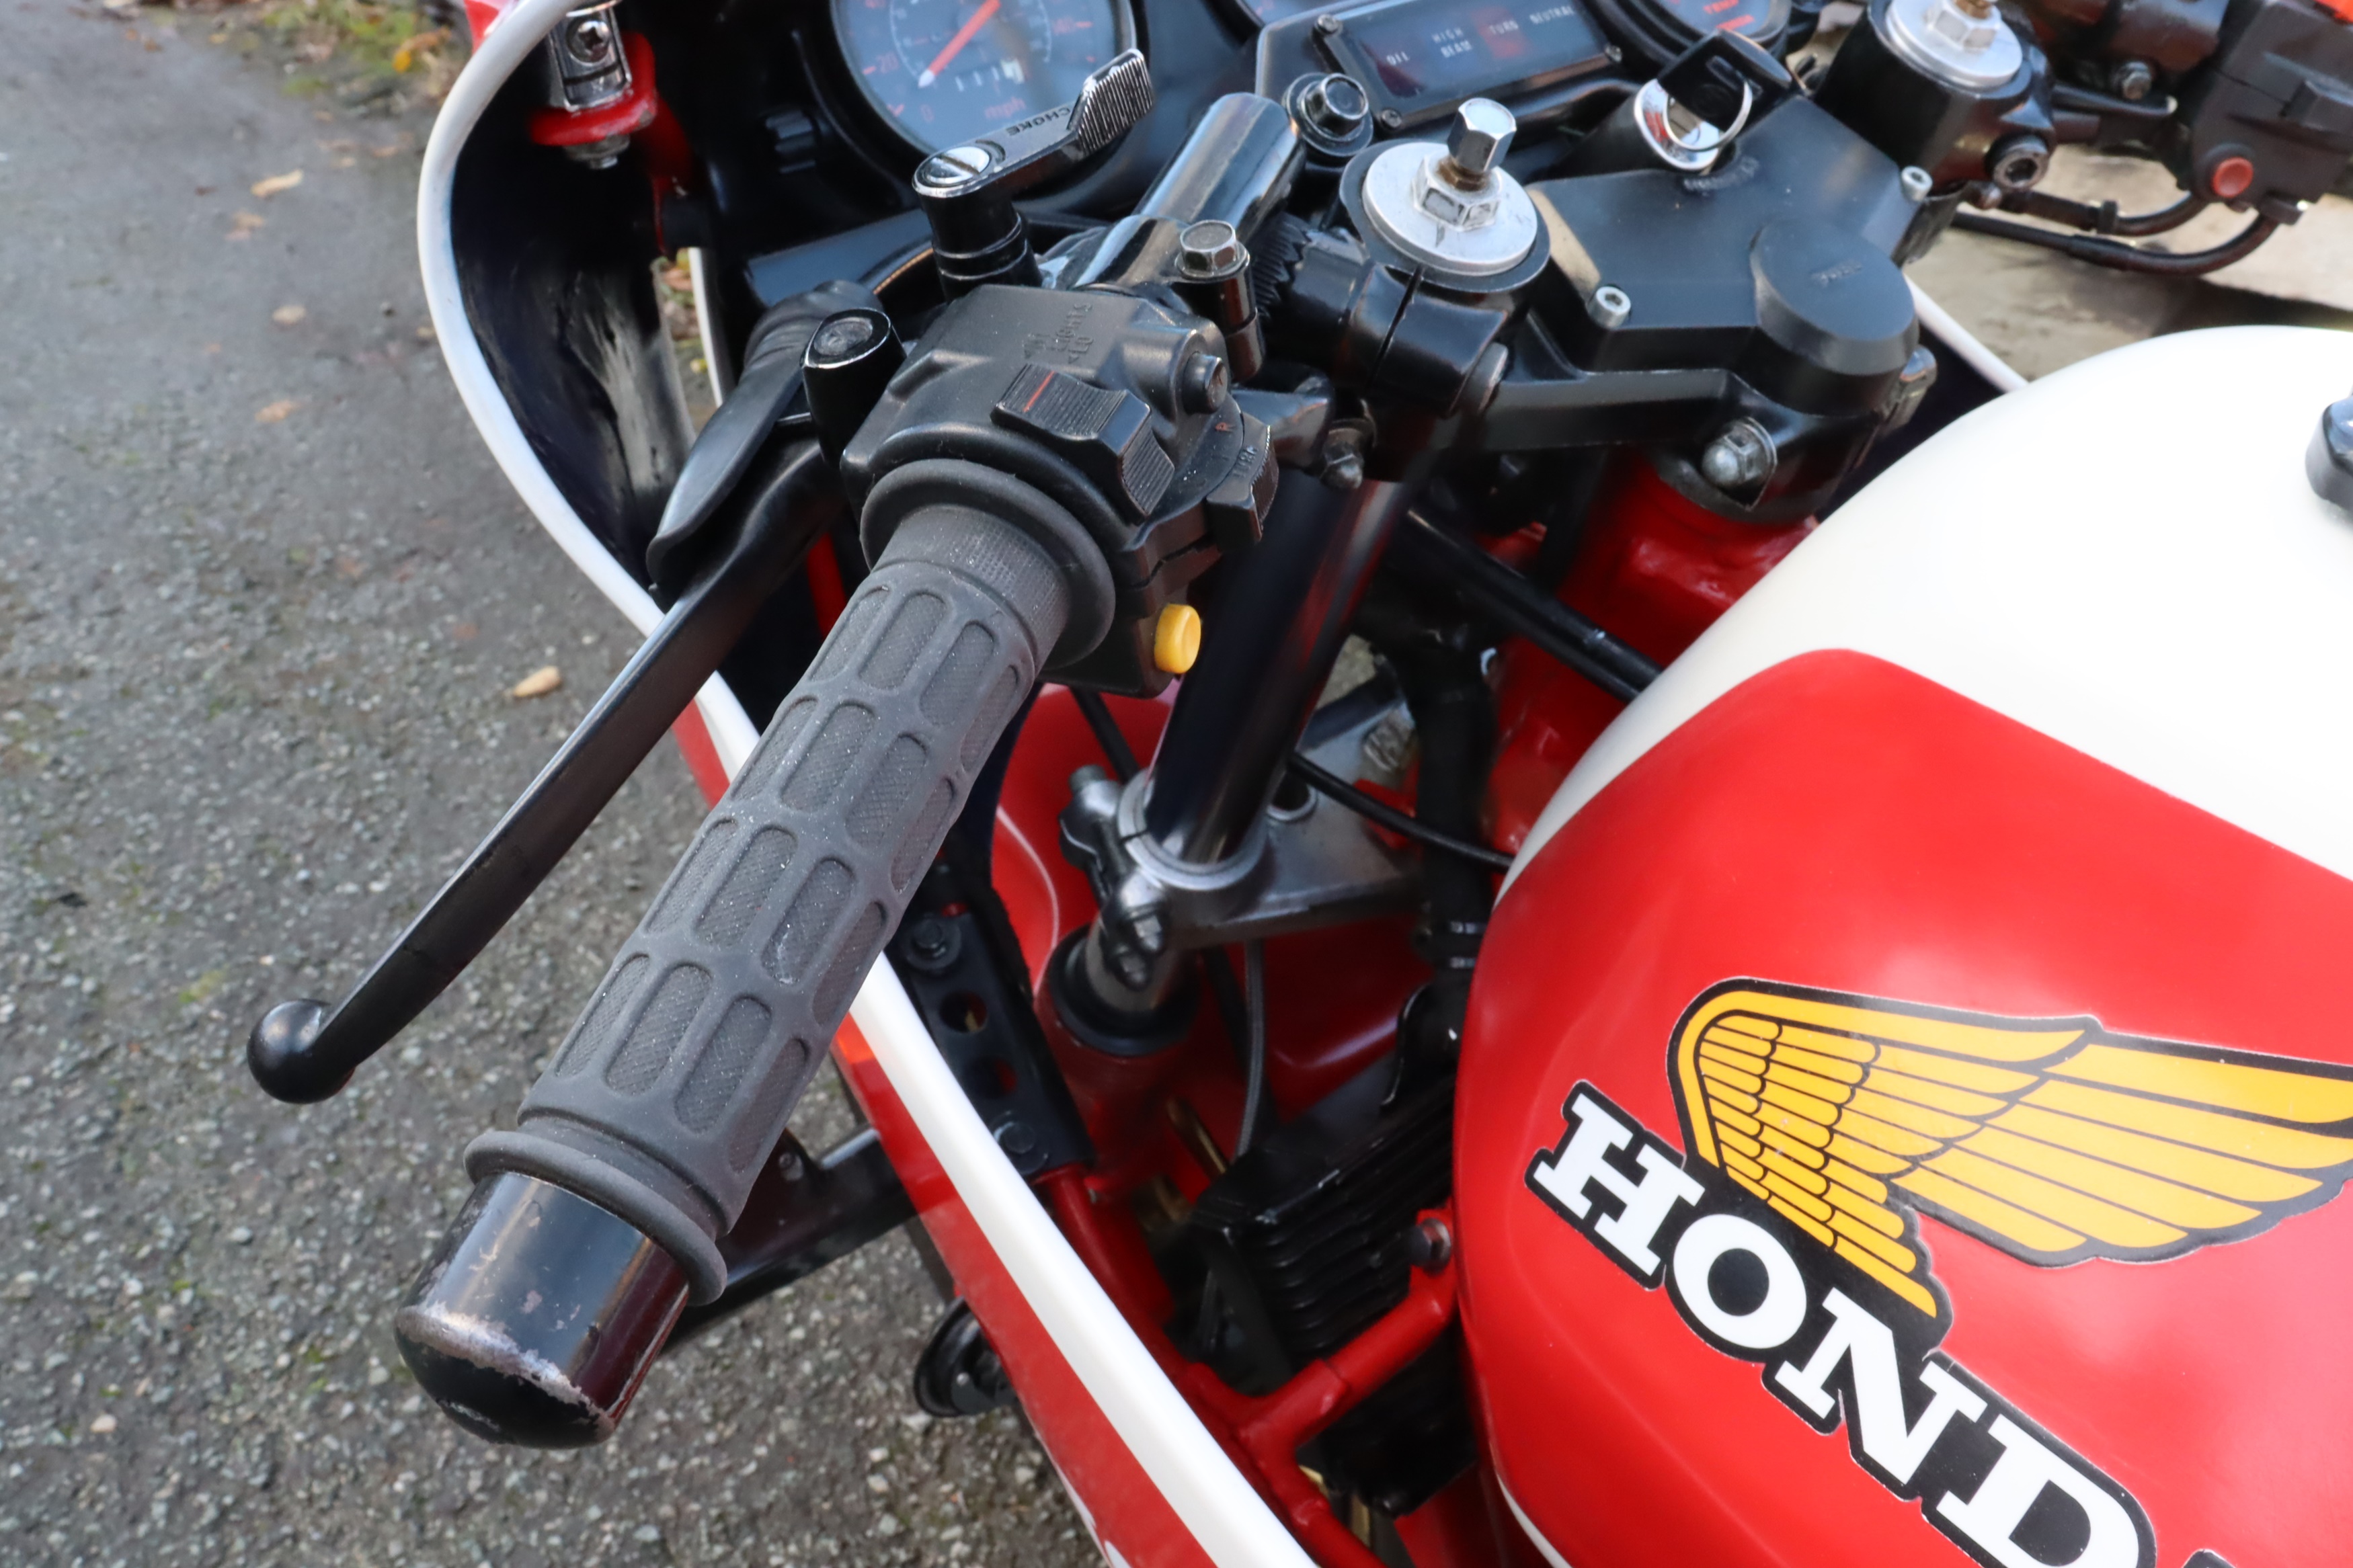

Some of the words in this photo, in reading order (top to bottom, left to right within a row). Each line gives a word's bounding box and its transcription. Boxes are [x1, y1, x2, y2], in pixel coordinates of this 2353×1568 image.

[1529, 5, 1576, 24] NEUTRAL
[1431, 27, 1464, 44] HIGH
[1440, 40, 1473, 58] BEAM
[1386, 50, 1410, 67] OIL
[1006, 107, 1071, 136] CHOKE
[1532, 1091, 2145, 1568] HOND
